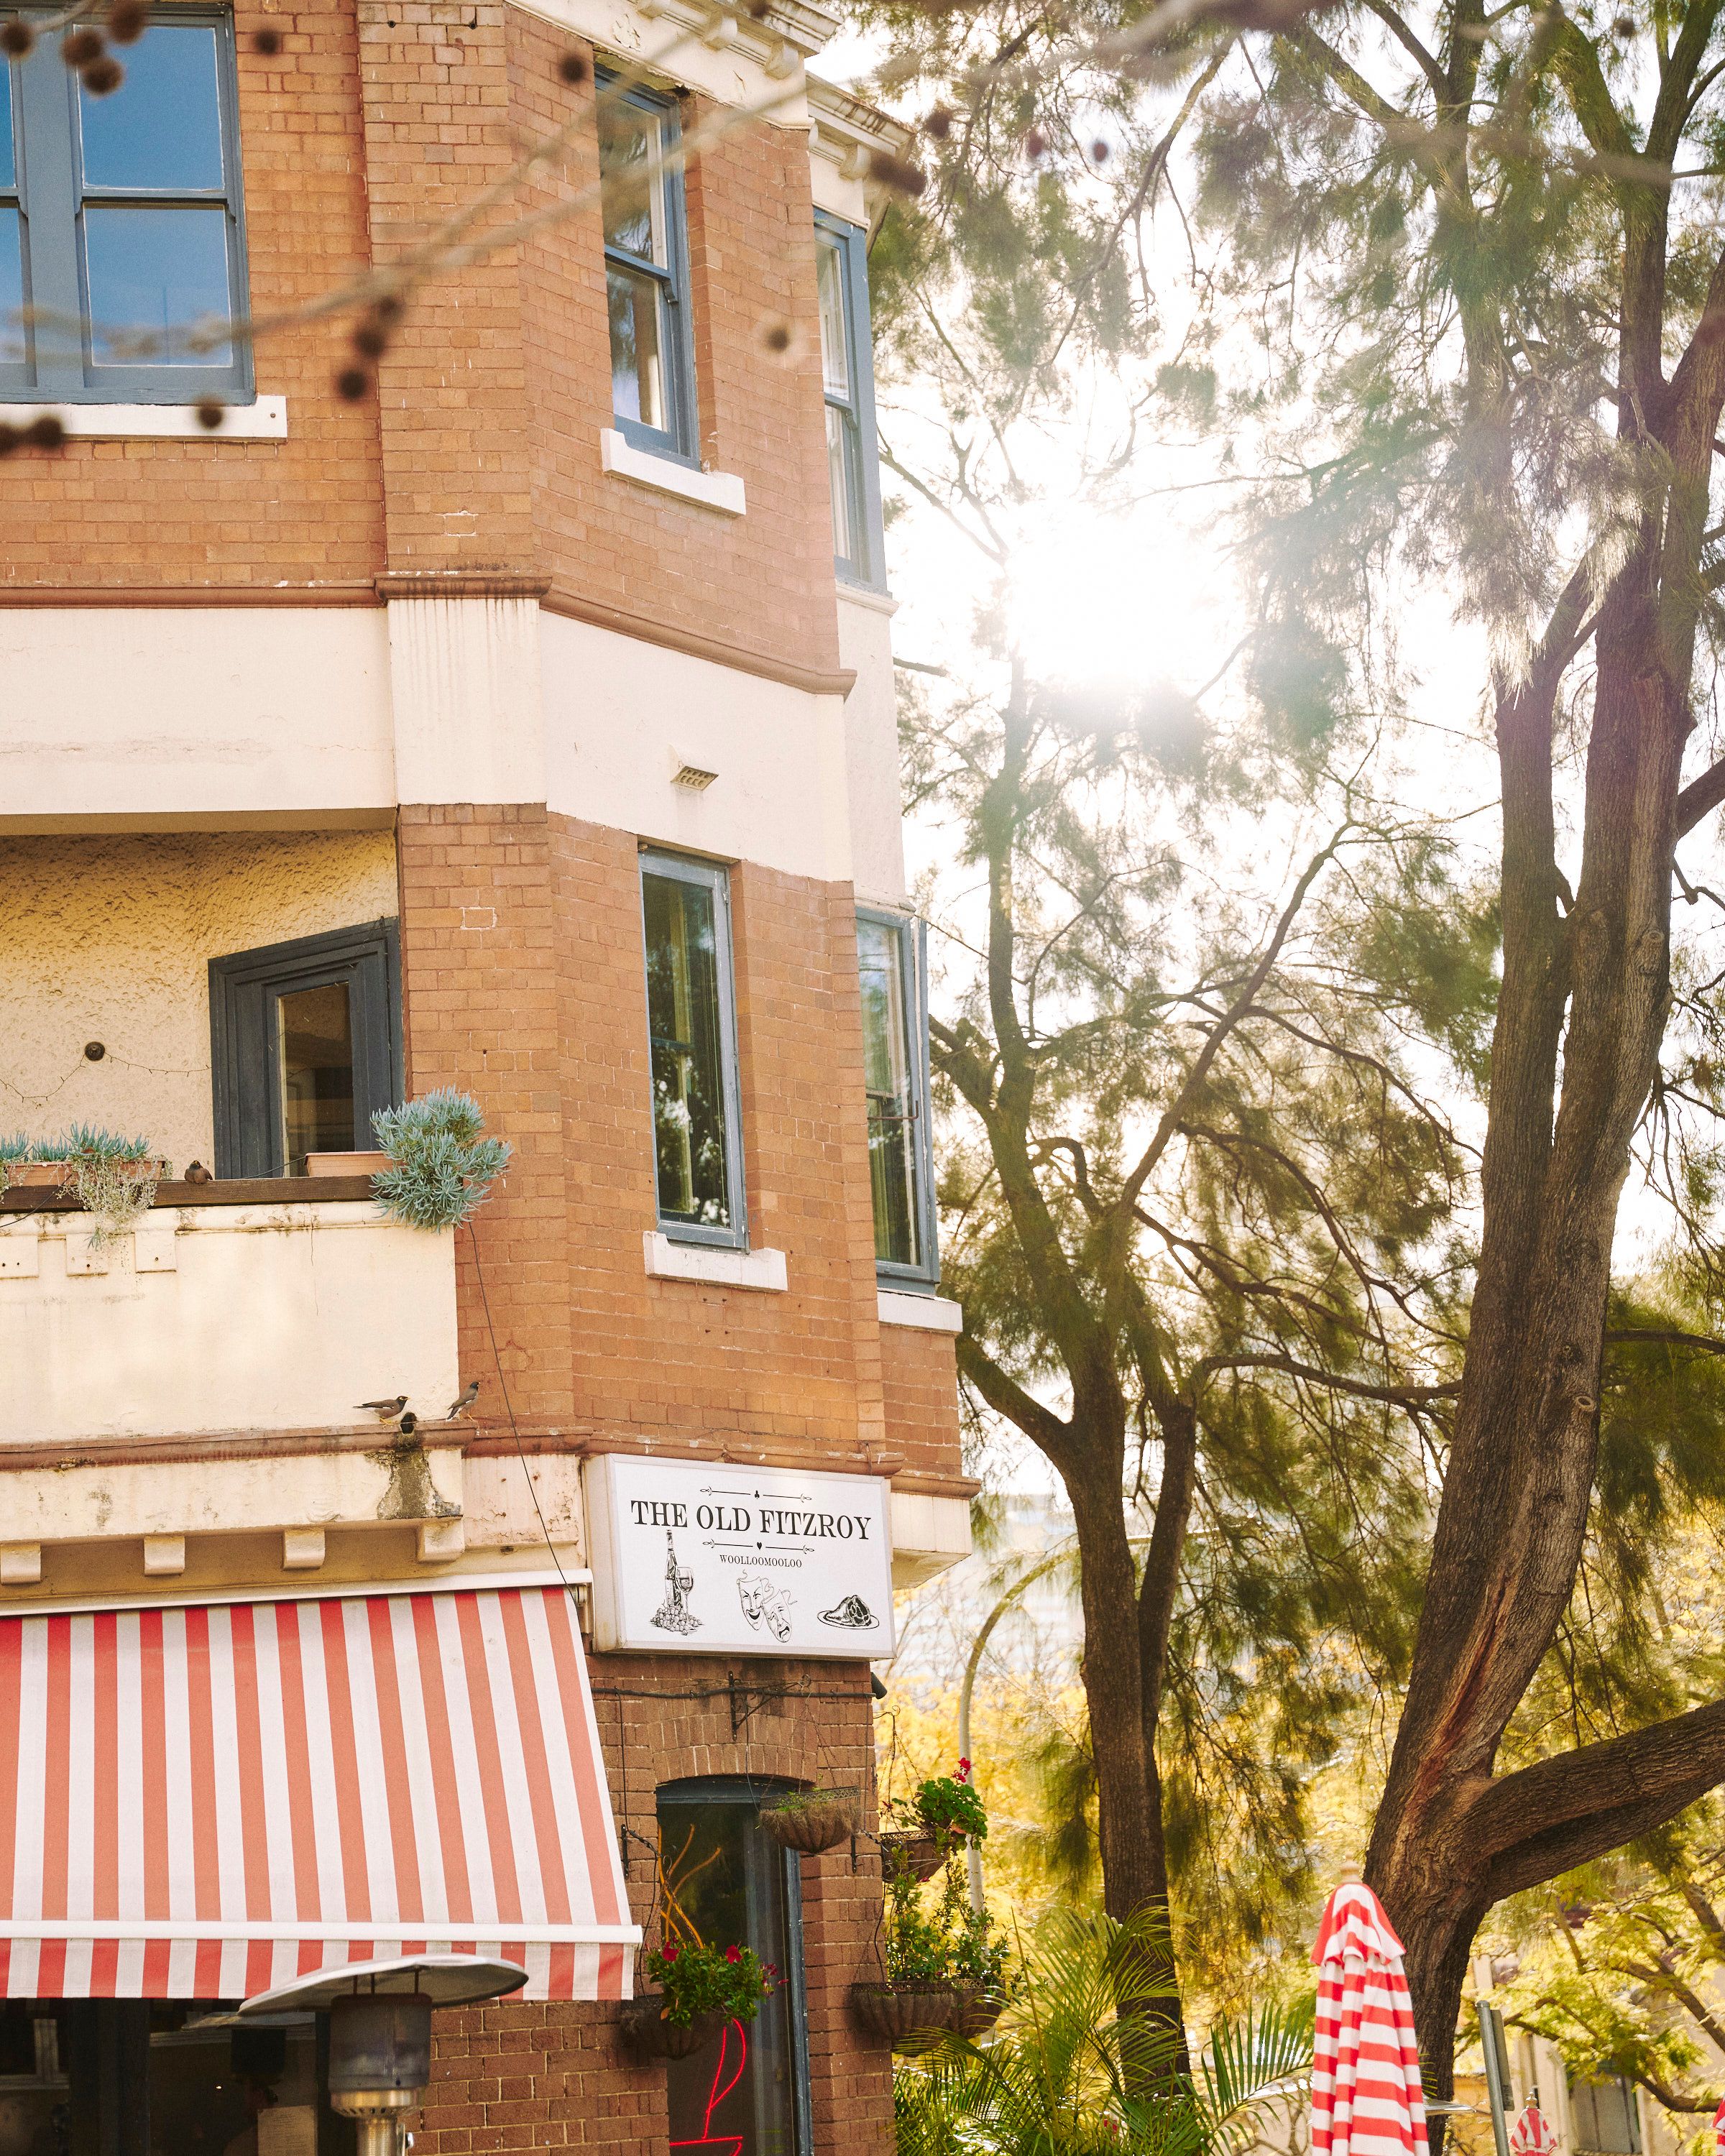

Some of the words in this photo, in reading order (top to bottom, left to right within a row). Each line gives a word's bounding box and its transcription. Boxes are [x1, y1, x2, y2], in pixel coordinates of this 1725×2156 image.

[630, 1500, 688, 1528] THE
[696, 1505, 751, 1531] OLD
[758, 1509, 872, 1540] FITZROY
[719, 1554, 802, 1568] WOOLLOOMOOLOO
